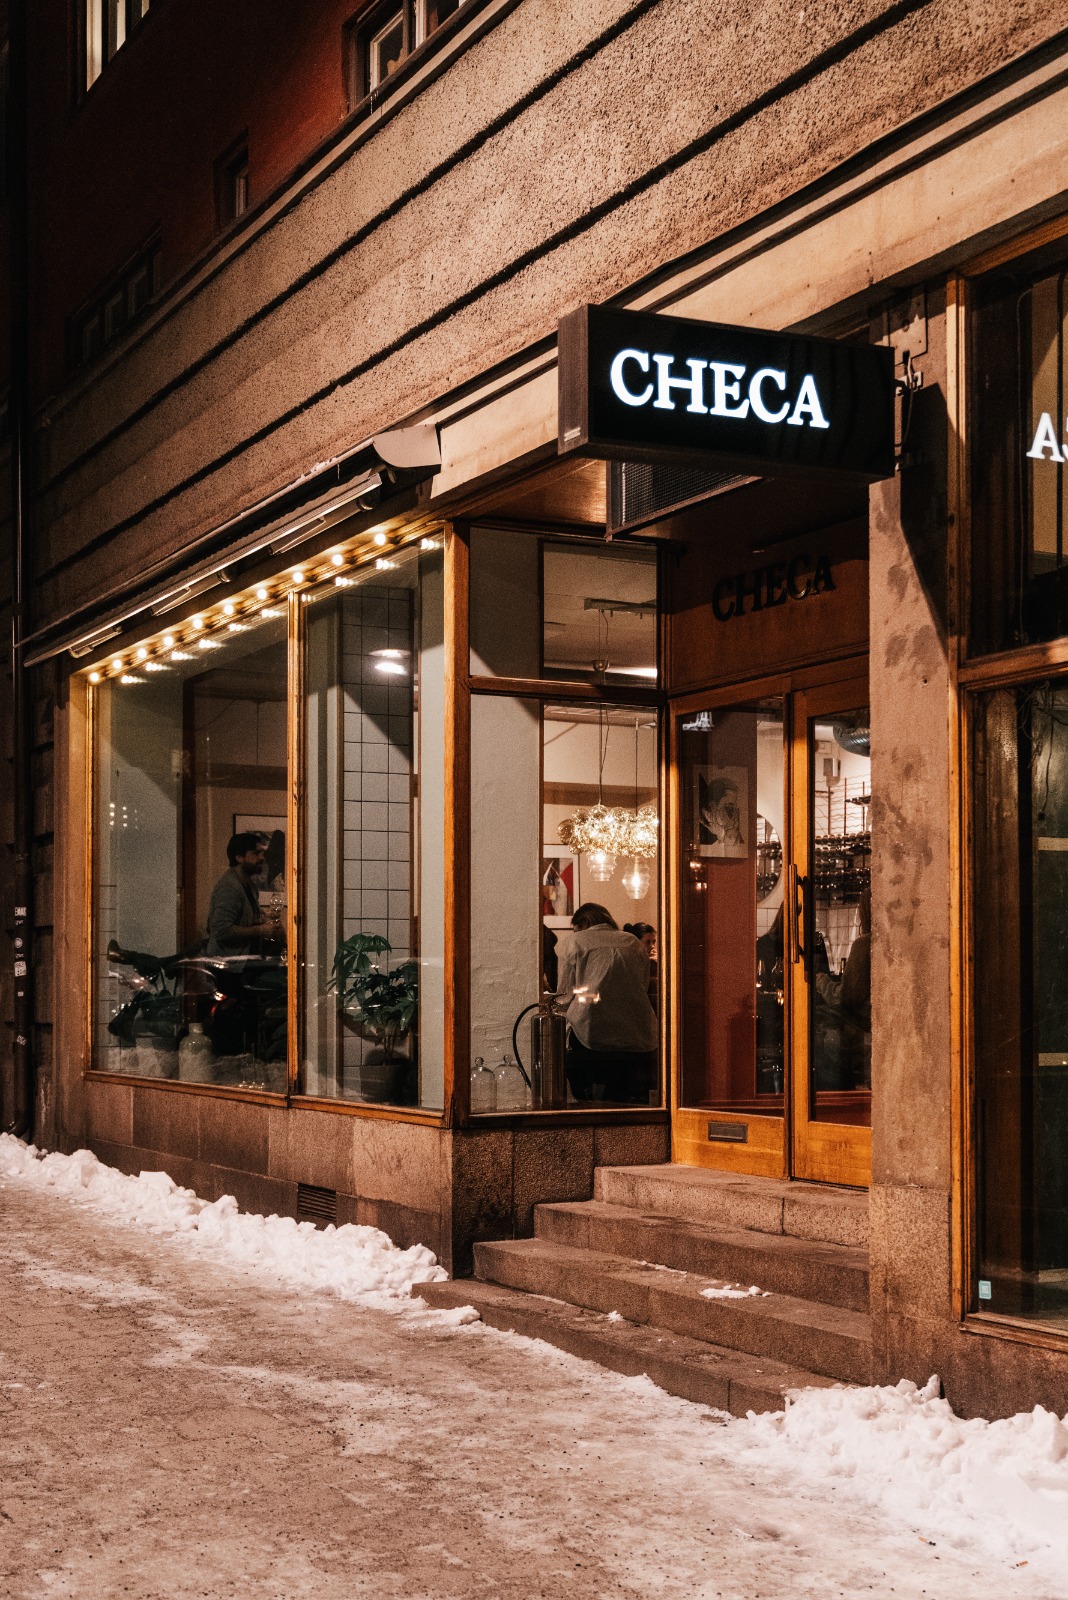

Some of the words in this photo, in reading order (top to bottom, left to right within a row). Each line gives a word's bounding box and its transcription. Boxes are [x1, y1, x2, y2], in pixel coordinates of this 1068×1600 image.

[610, 348, 830, 429] CHECA
[1026, 412, 1068, 463] A
[712, 553, 837, 622] CHECA
